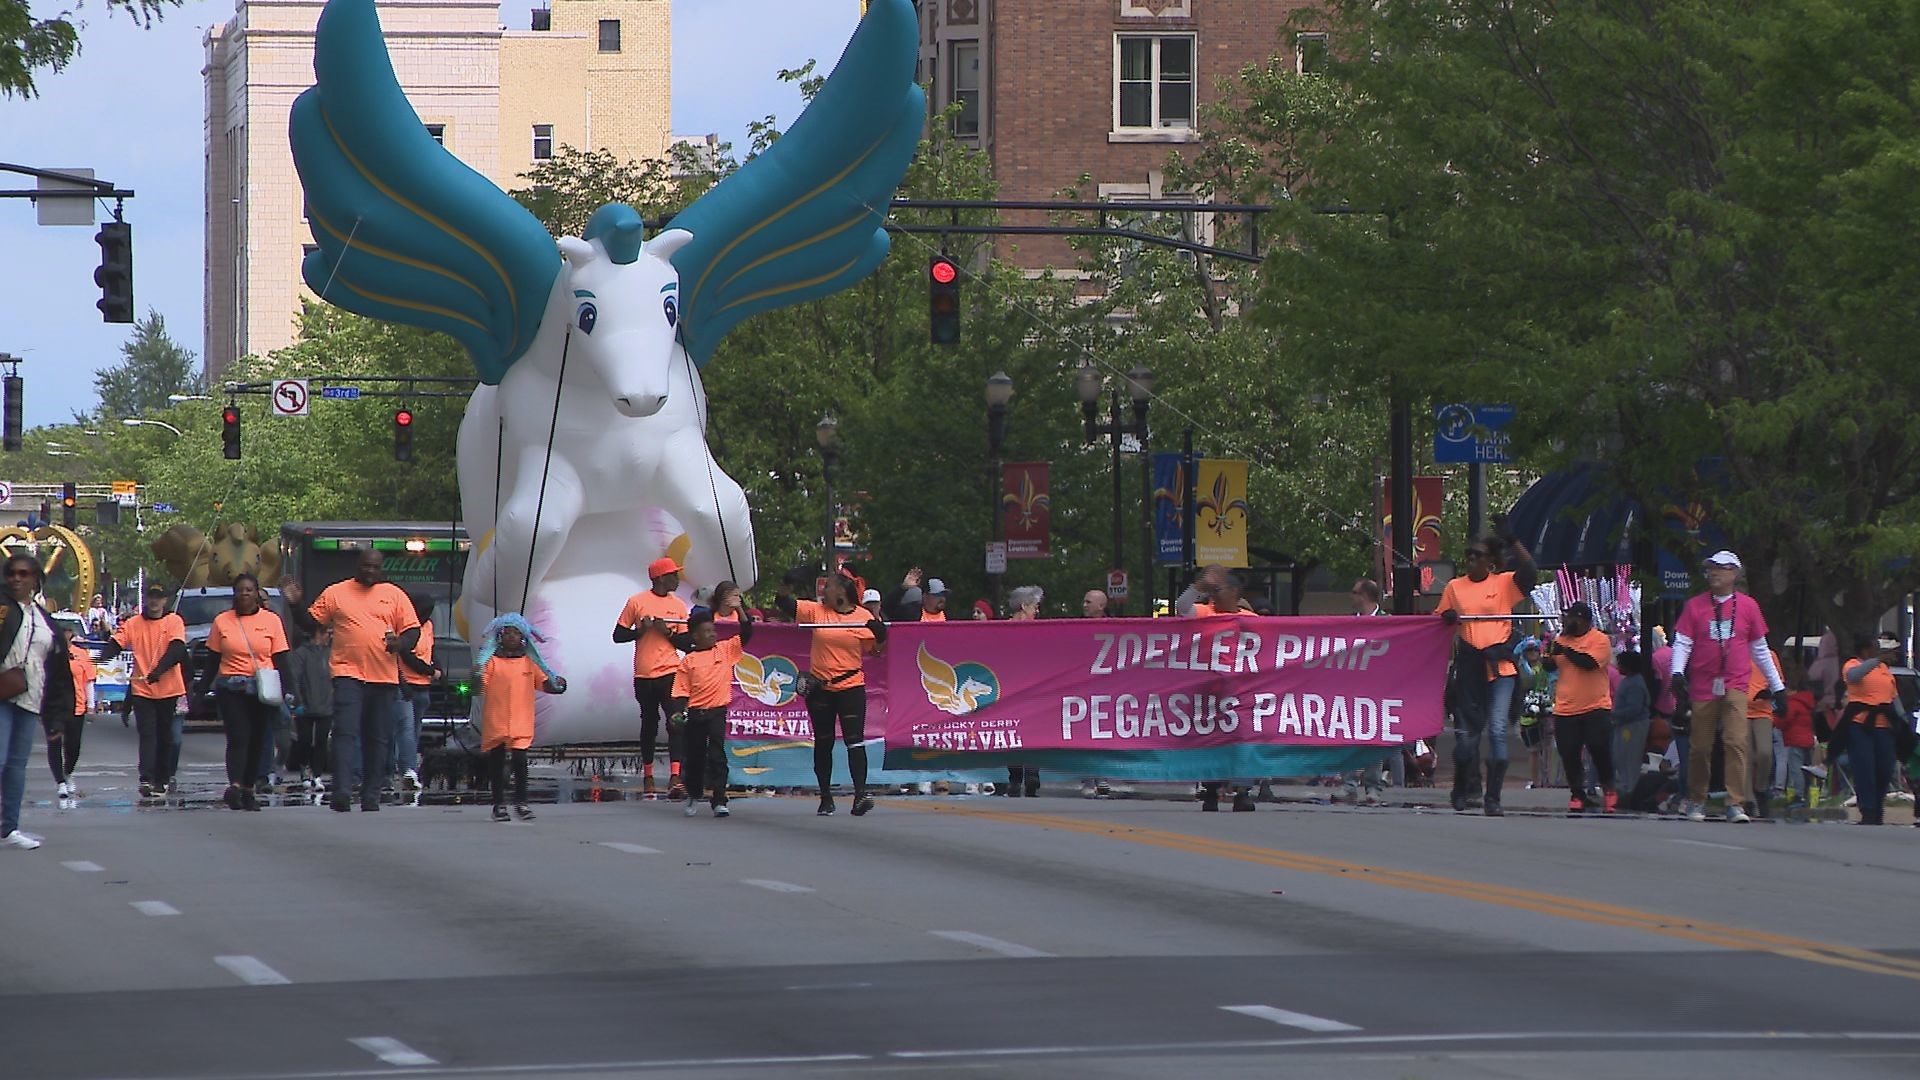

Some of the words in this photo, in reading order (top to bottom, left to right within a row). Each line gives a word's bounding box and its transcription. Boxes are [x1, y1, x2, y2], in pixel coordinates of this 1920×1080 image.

[335, 389, 350, 398] 3rd
[1091, 631, 1262, 674] ZOELLER
[1275, 634, 1390, 670] PUMP
[981, 719, 1021, 728] DERBY
[1062, 693, 1240, 740] PEGASUS
[1253, 692, 1404, 742] PARADE
[729, 719, 815, 736] FESTIVA
